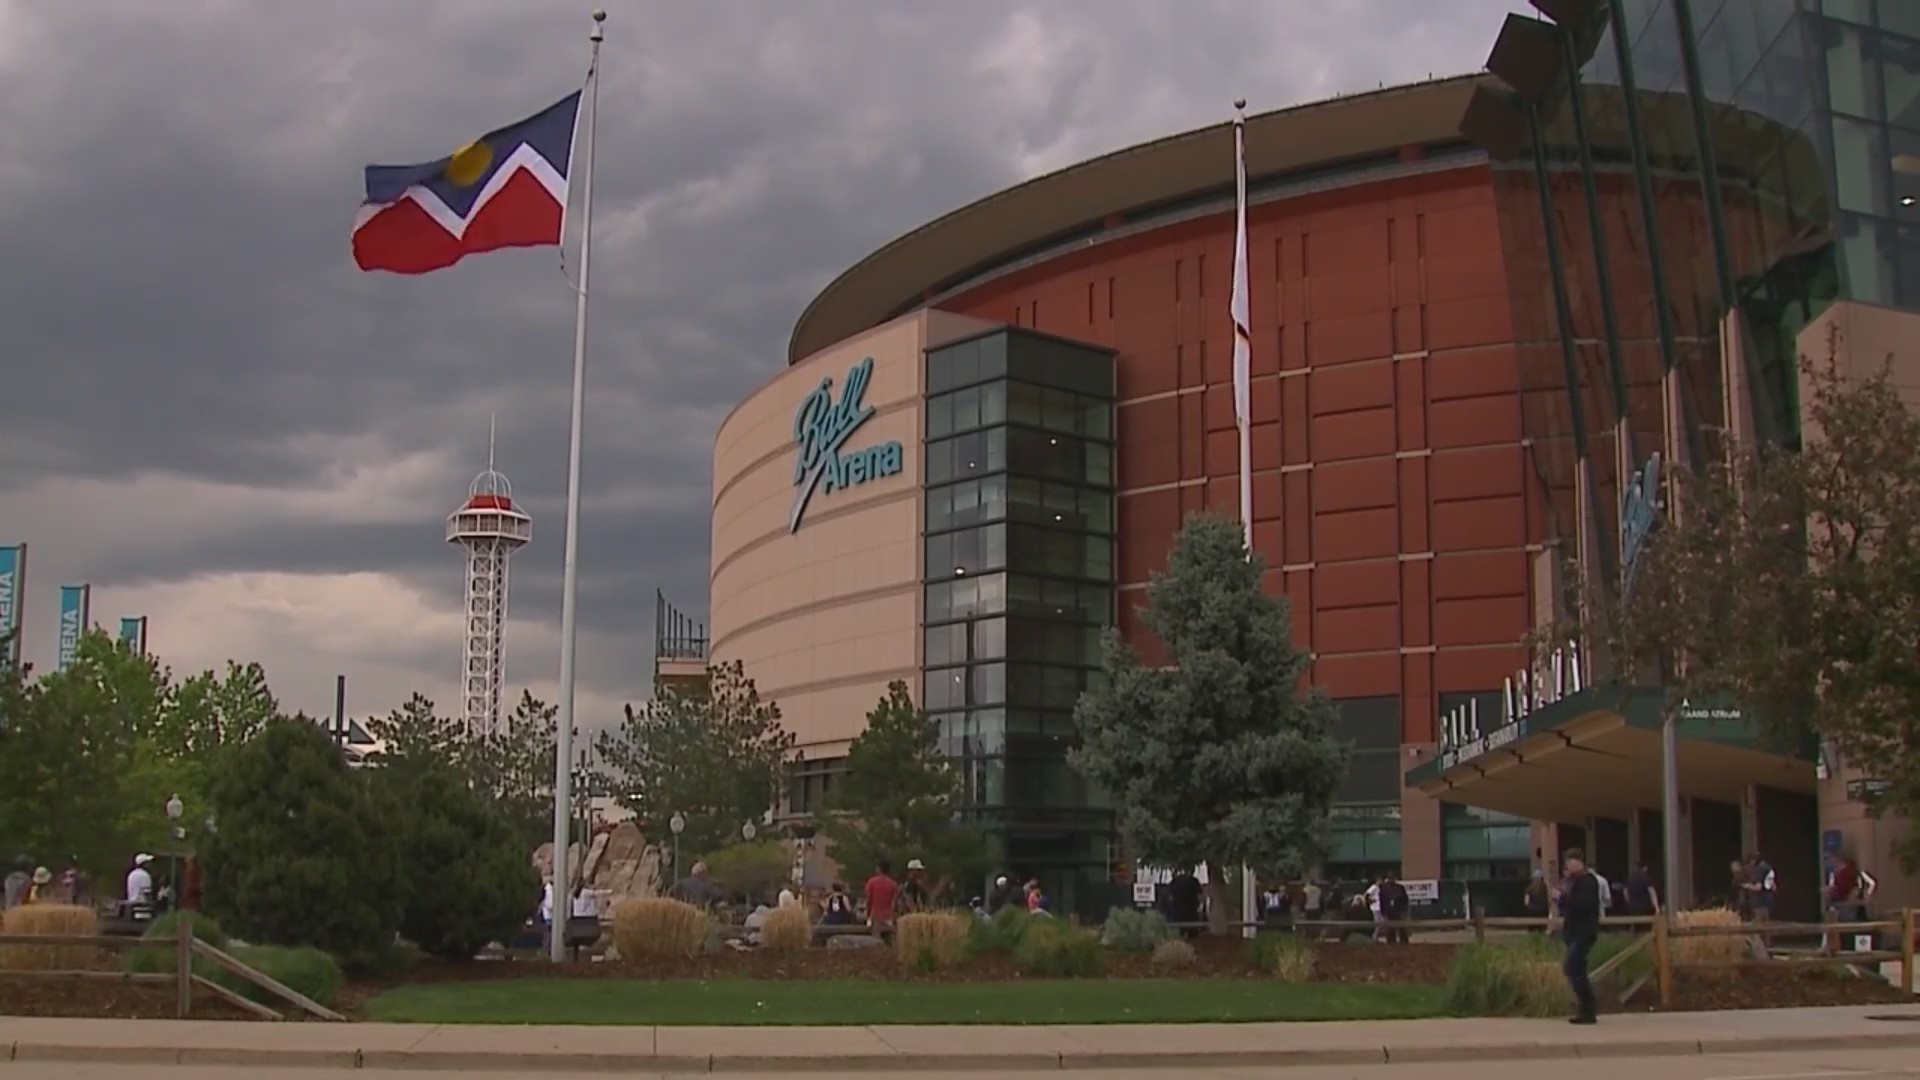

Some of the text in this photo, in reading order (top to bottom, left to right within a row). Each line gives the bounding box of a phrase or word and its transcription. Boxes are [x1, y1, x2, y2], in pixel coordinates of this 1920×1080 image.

[790, 356, 876, 534] Ball
[823, 441, 903, 495] Arena
[0, 571, 13, 634] RENA
[60, 609, 78, 673] RENA
[1440, 697, 1480, 754] BALL
[1502, 638, 1581, 726] ARENA
